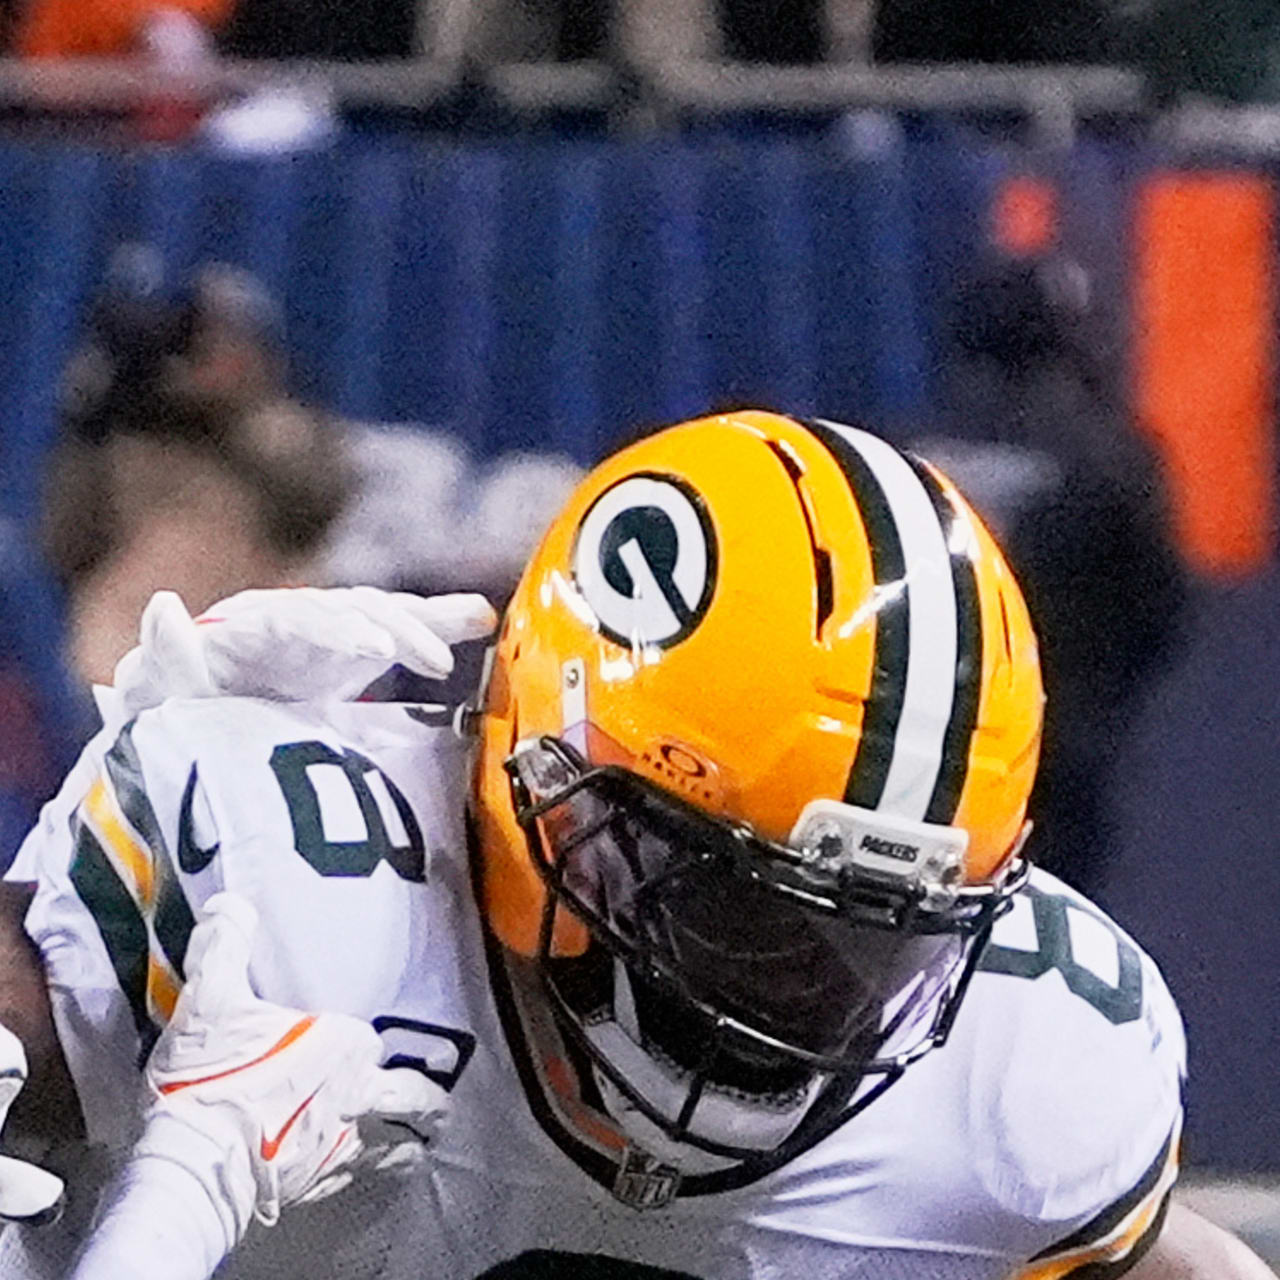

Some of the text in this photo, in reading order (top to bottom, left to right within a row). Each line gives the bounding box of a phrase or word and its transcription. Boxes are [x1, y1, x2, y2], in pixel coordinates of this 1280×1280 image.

[573, 471, 719, 652] G
[268, 740, 428, 884] 8
[859, 834, 920, 863] PACKERS
